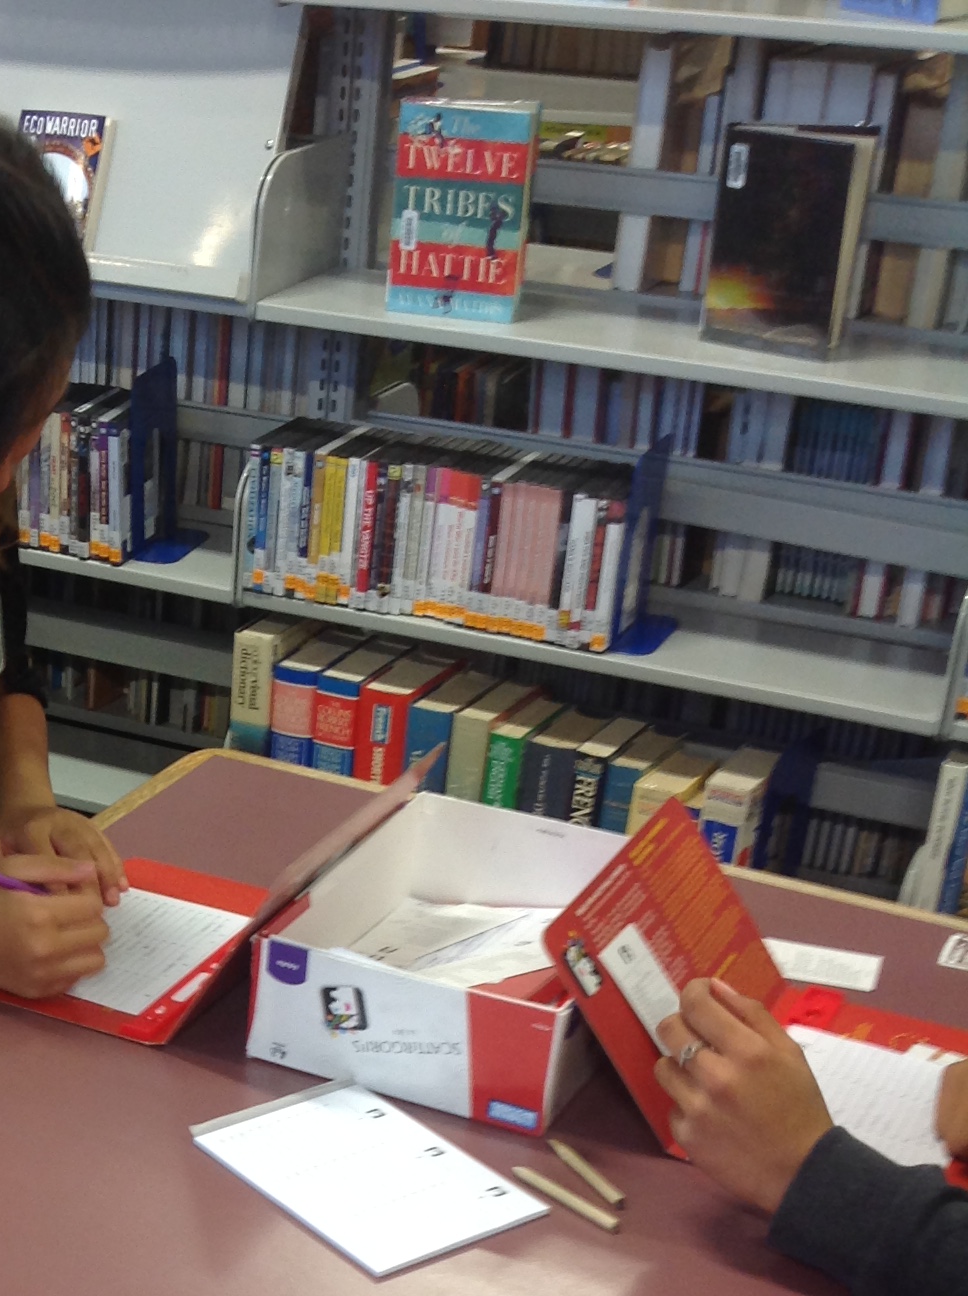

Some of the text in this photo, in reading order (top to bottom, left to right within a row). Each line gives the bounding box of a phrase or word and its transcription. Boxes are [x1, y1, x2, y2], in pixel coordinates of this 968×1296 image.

[23, 115, 99, 137] ECO WARRIOR
[404, 143, 521, 179] TWELVE
[403, 185, 516, 222] TRIBES
[398, 249, 509, 285] HATTIE
[363, 490, 375, 505] UP
[236, 647, 251, 709] dictionary
